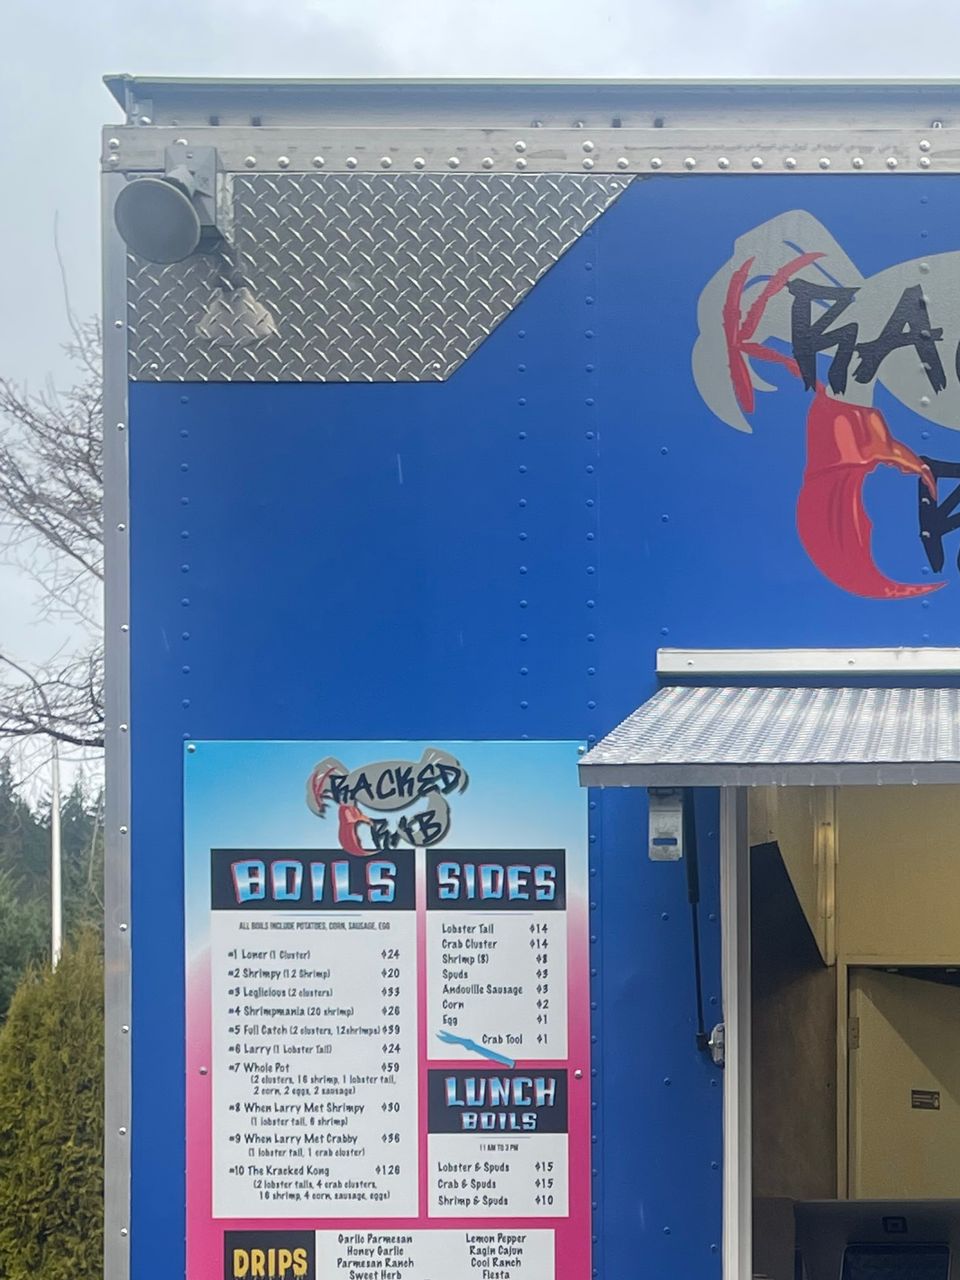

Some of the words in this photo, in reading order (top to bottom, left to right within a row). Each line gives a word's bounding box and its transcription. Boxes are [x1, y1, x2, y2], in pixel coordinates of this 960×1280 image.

[312, 763, 461, 813] KRACKED
[231, 860, 397, 904] BOILS
[437, 861, 556, 900] SIDES
[442, 924, 477, 934] Lobster
[479, 924, 494, 934] Tail
[529, 924, 548, 934] $14
[442, 939, 463, 949] Crab
[465, 939, 497, 949] Cluster
[530, 939, 549, 949] $14
[442, 969, 468, 981] Spuds
[536, 969, 548, 981] $3
[442, 985, 484, 995] Andouille
[486, 985, 523, 995] Sausage
[536, 985, 548, 995] $3
[442, 999, 464, 1009] Corn
[537, 999, 549, 1009] $2
[442, 1014, 458, 1026] Egg
[537, 1014, 548, 1024] $1
[482, 1035, 503, 1044] Crab
[506, 1035, 523, 1044] Tool
[537, 1035, 548, 1044] $1
[445, 1076, 556, 1107] LUNCH
[462, 1112, 537, 1130] BOILS
[438, 1162, 472, 1172] Lobster
[475, 1163, 481, 1172] &
[484, 1162, 510, 1172] Spuds
[535, 1162, 553, 1172] $15
[438, 1179, 459, 1189] Crab
[462, 1179, 468, 1188] &
[471, 1179, 496, 1190] Spuds
[535, 1178, 553, 1188] $15
[438, 1196, 470, 1207] Shrimp
[473, 1196, 480, 1205] &
[483, 1196, 508, 1206] Spuds
[535, 1195, 553, 1205] $10
[466, 1233, 495, 1243] Lemon
[498, 1233, 526, 1244] Pepper
[337, 1258, 382, 1268] Parmesan
[385, 1258, 414, 1268] Ranch
[471, 1258, 489, 1267] Cool
[492, 1258, 521, 1267] Ranch
[350, 1270, 378, 1280] Sweet
[381, 1270, 402, 1280] Herb
